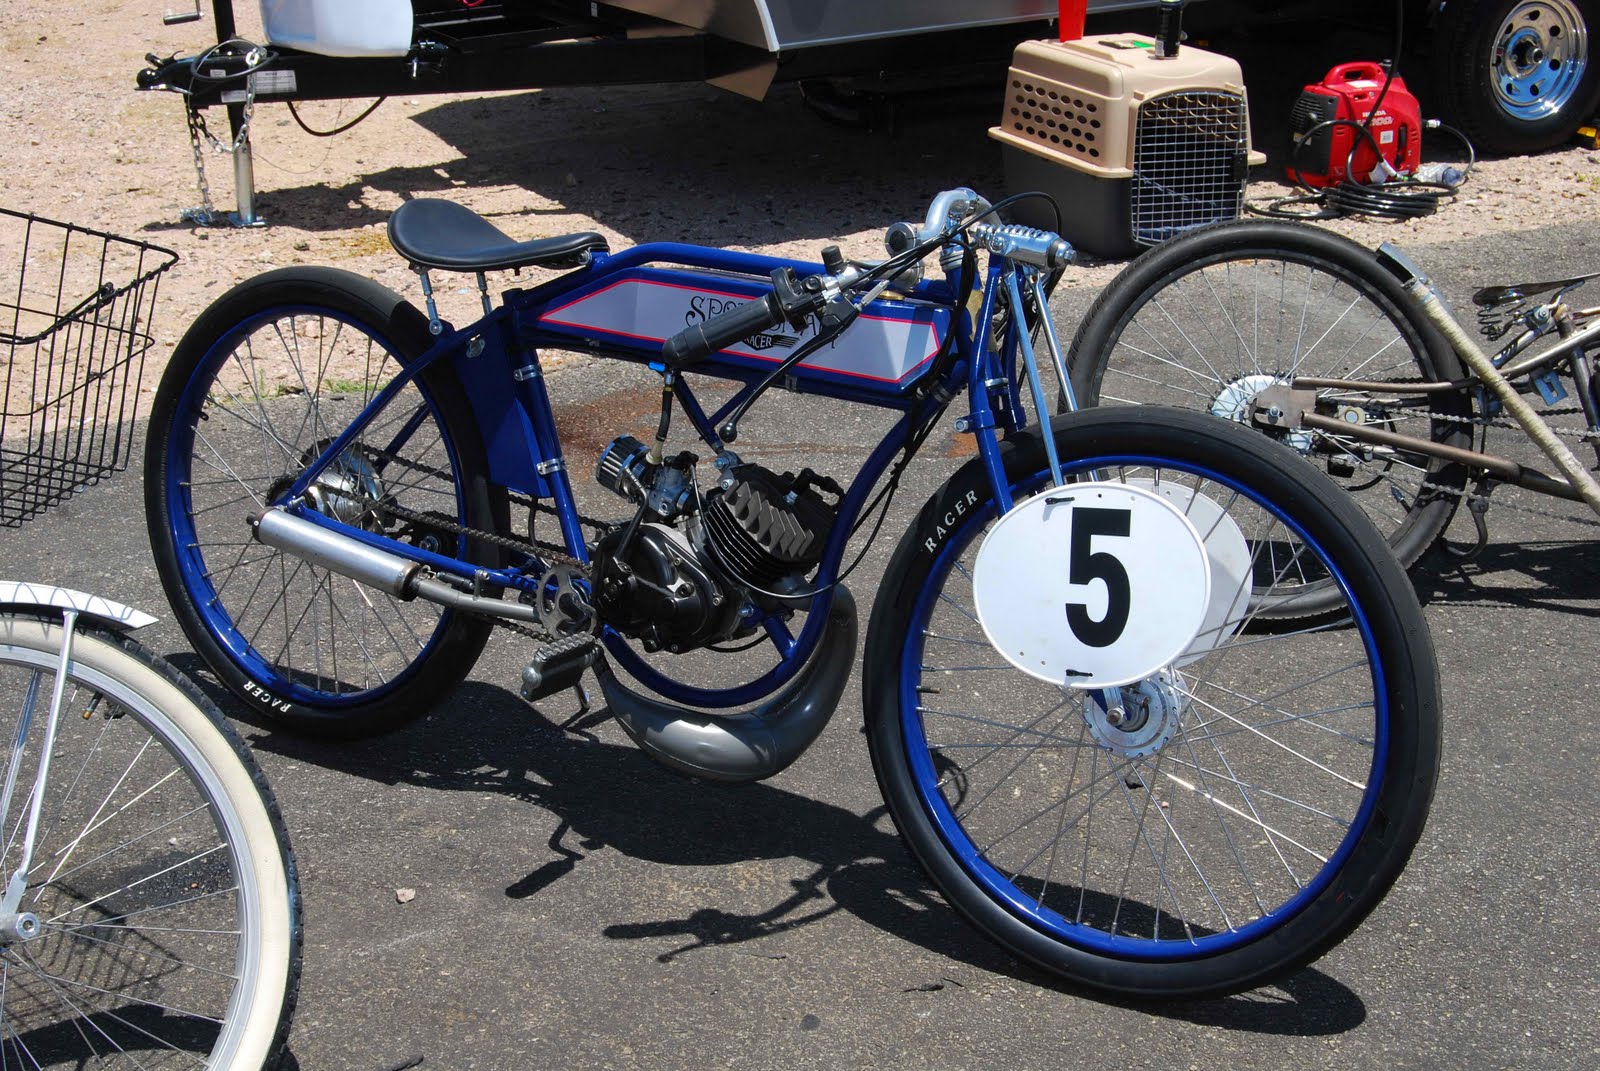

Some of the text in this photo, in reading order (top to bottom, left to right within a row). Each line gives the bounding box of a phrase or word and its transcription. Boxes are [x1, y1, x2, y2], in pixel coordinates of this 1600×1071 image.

[924, 490, 978, 553] RACER
[1065, 506, 1132, 648] 5
[243, 680, 292, 713] RACER
